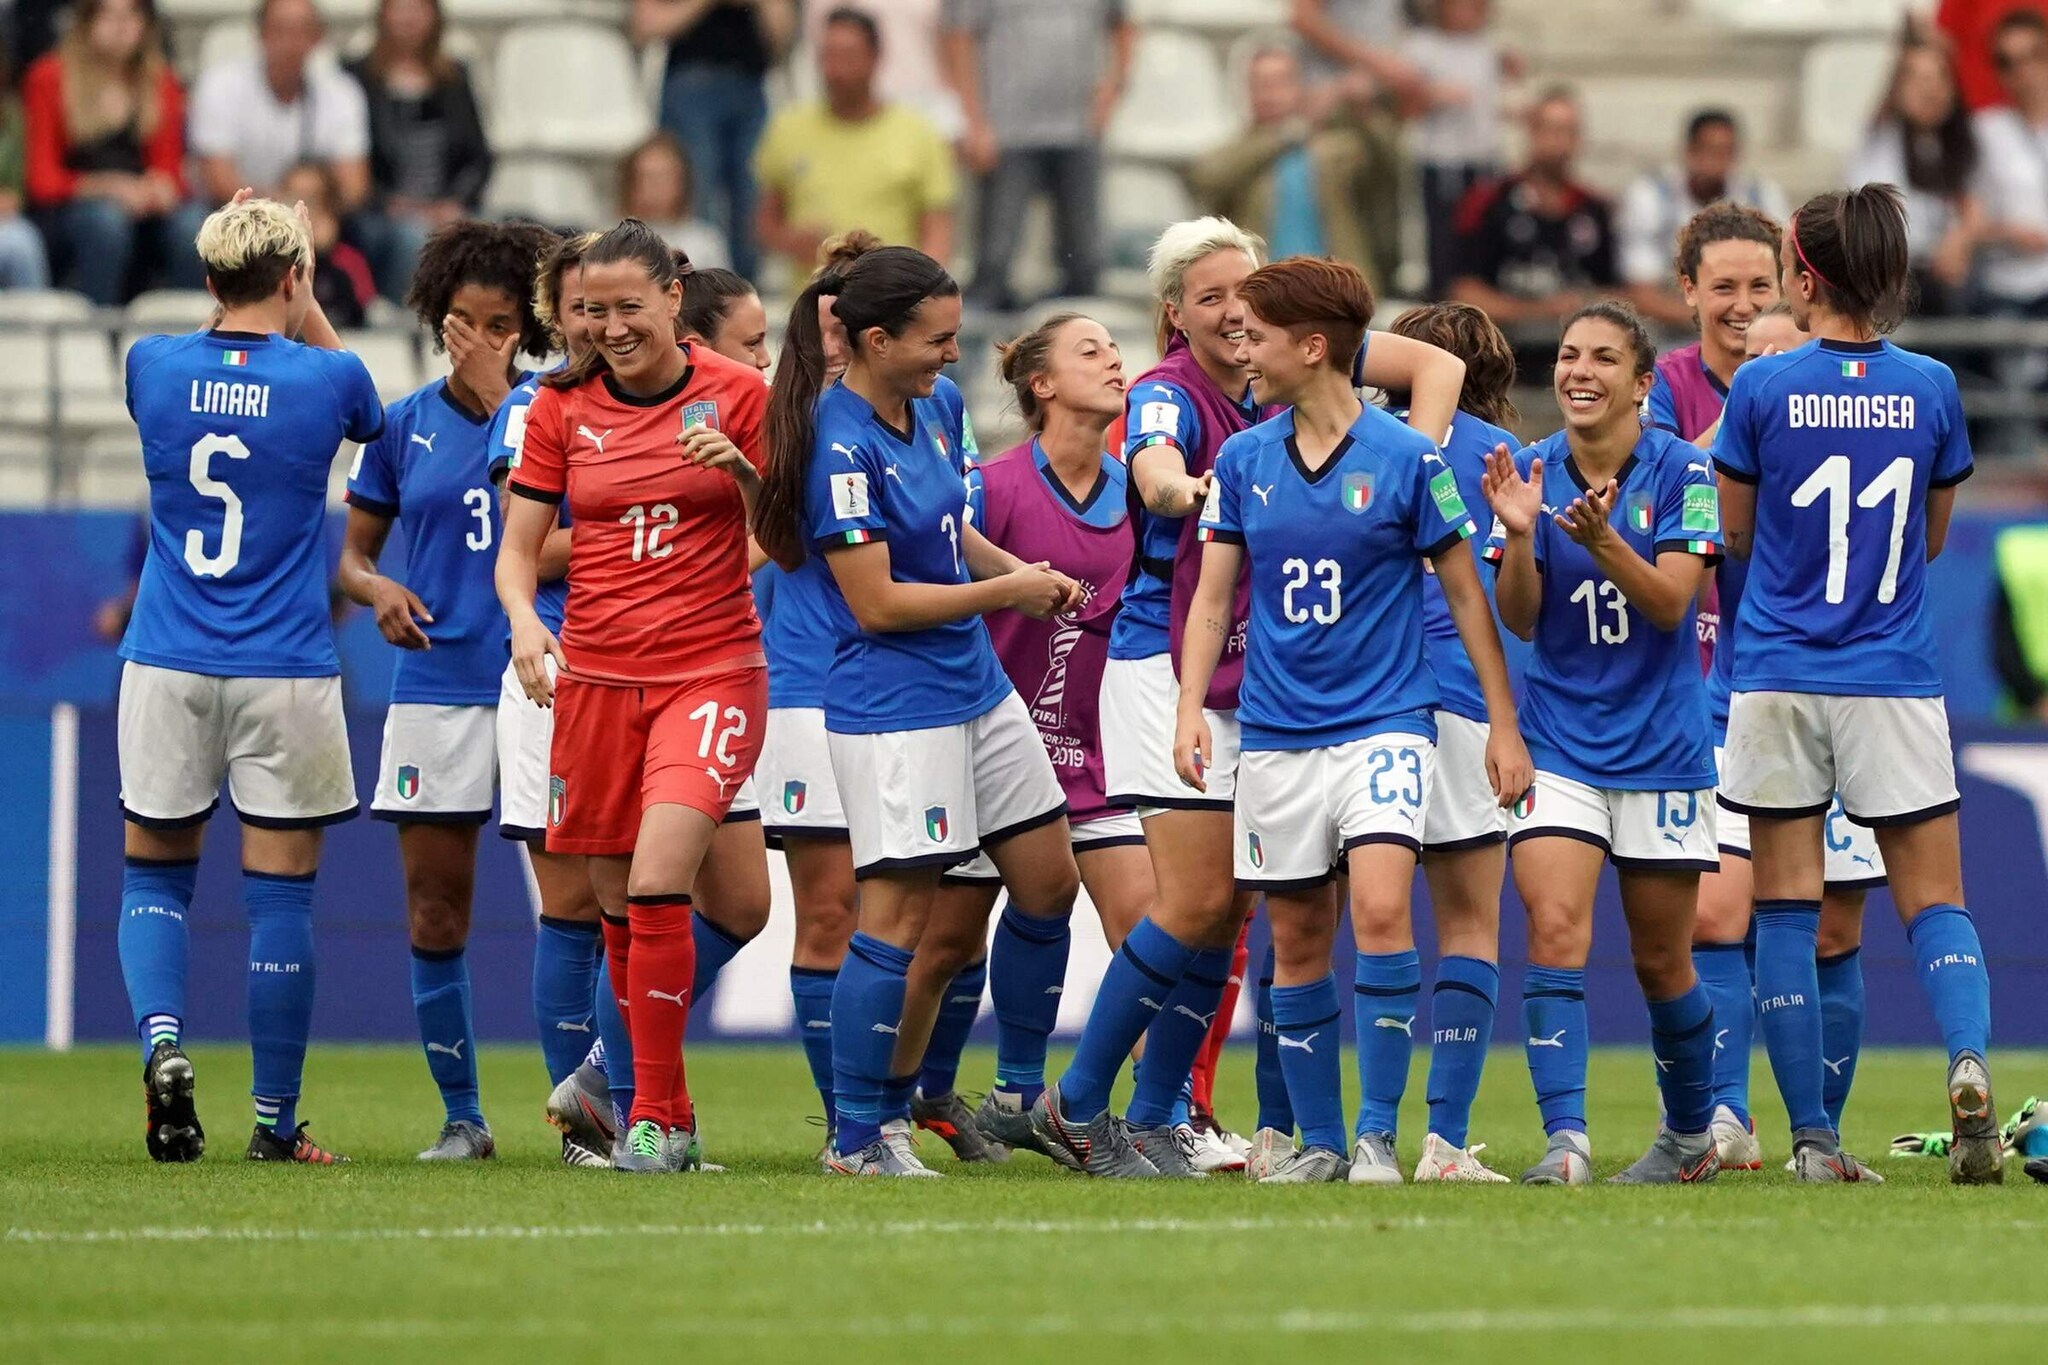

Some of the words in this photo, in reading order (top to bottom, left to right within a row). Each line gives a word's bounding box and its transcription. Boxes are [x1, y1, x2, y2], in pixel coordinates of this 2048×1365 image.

[190, 380, 270, 418] LINARI
[1788, 394, 1915, 429] BONANSEA
[184, 432, 251, 579] 5
[463, 487, 492, 552] 3
[619, 503, 679, 562] 12
[1791, 455, 1915, 605] 11
[1282, 558, 1342, 625] 23
[1570, 580, 1629, 645] 13
[688, 701, 748, 768] 12
[1032, 709, 1057, 725] FIFA
[1367, 748, 1423, 808] 23
[131, 906, 183, 921] ITALIA
[251, 961, 300, 973] ITALIA
[1929, 953, 1977, 972] ITALIA
[1761, 994, 1804, 1014] ITALIA
[1434, 1027, 1477, 1044] ITALIA
